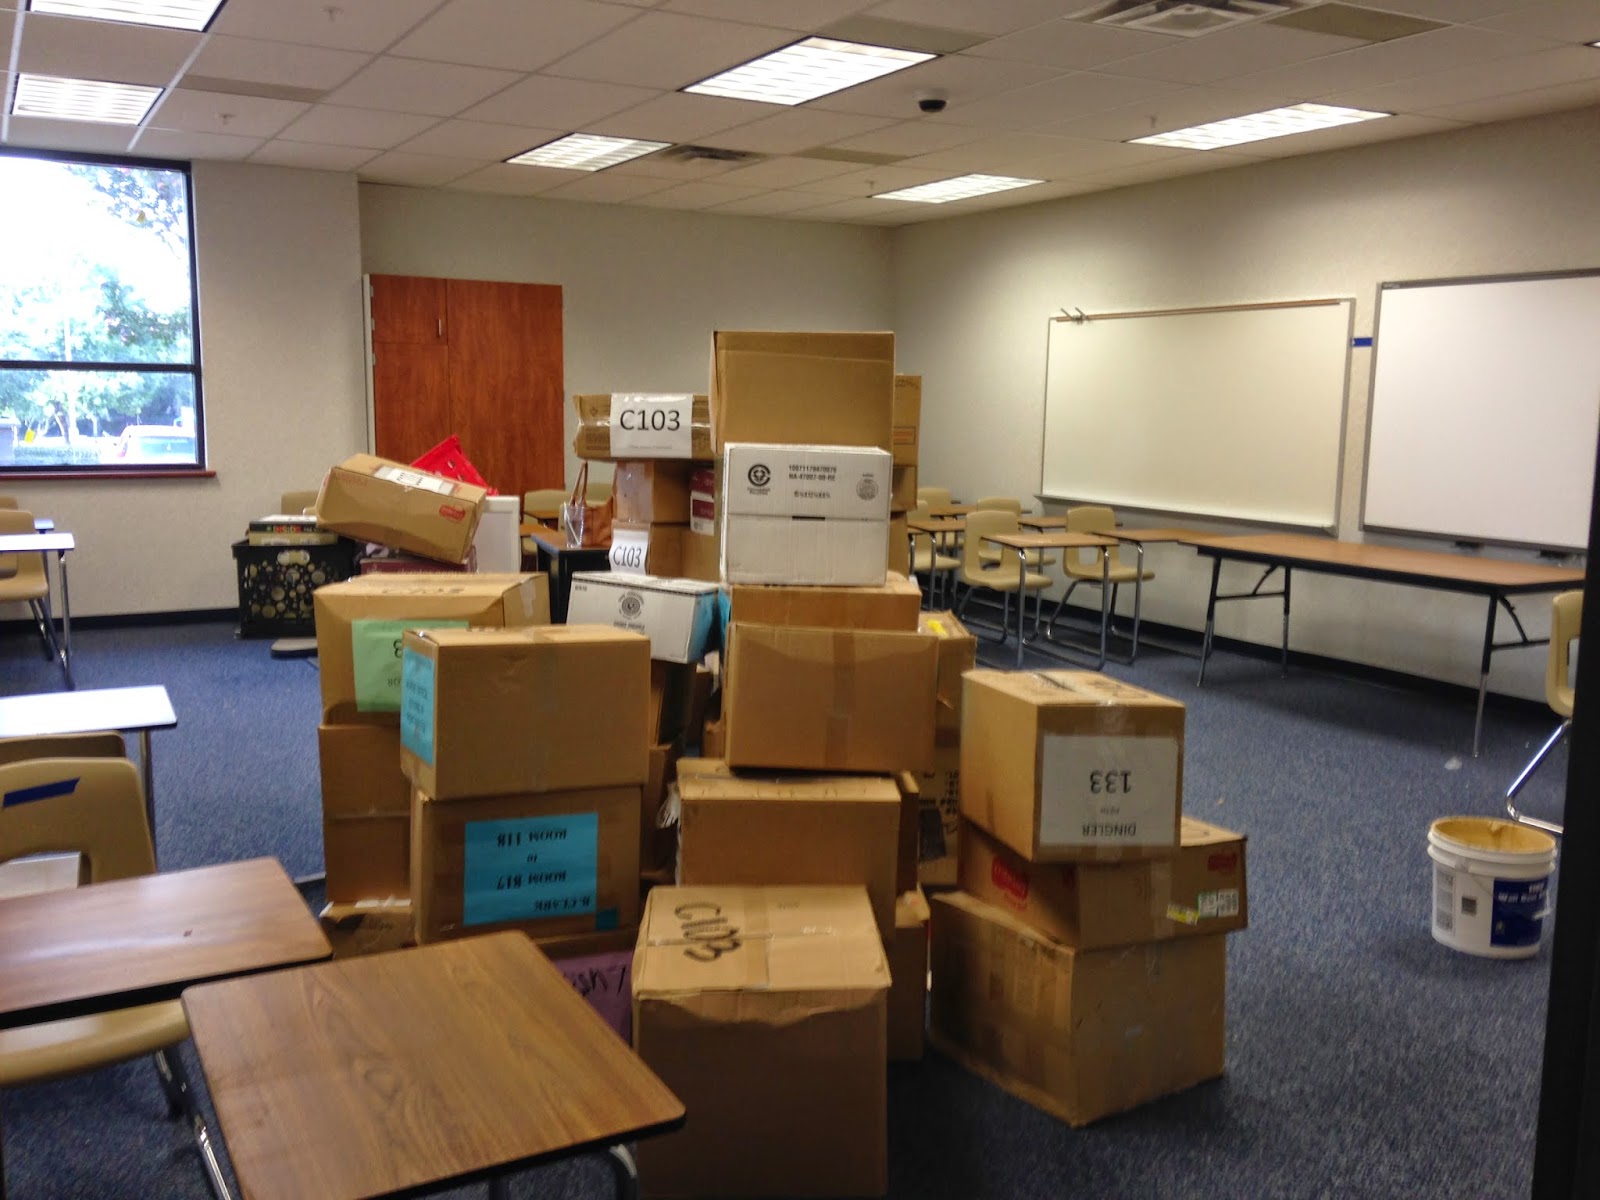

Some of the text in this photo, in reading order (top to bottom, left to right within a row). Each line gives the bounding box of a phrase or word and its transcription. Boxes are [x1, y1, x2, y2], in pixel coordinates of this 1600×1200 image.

[619, 408, 681, 432] C103
[612, 545, 642, 569] C103
[1089, 769, 1132, 795] 133
[528, 828, 568, 843] ROOM
[1081, 822, 1137, 838] DINGLER
[528, 870, 568, 886] ROOM
[673, 901, 742, 963] C103
